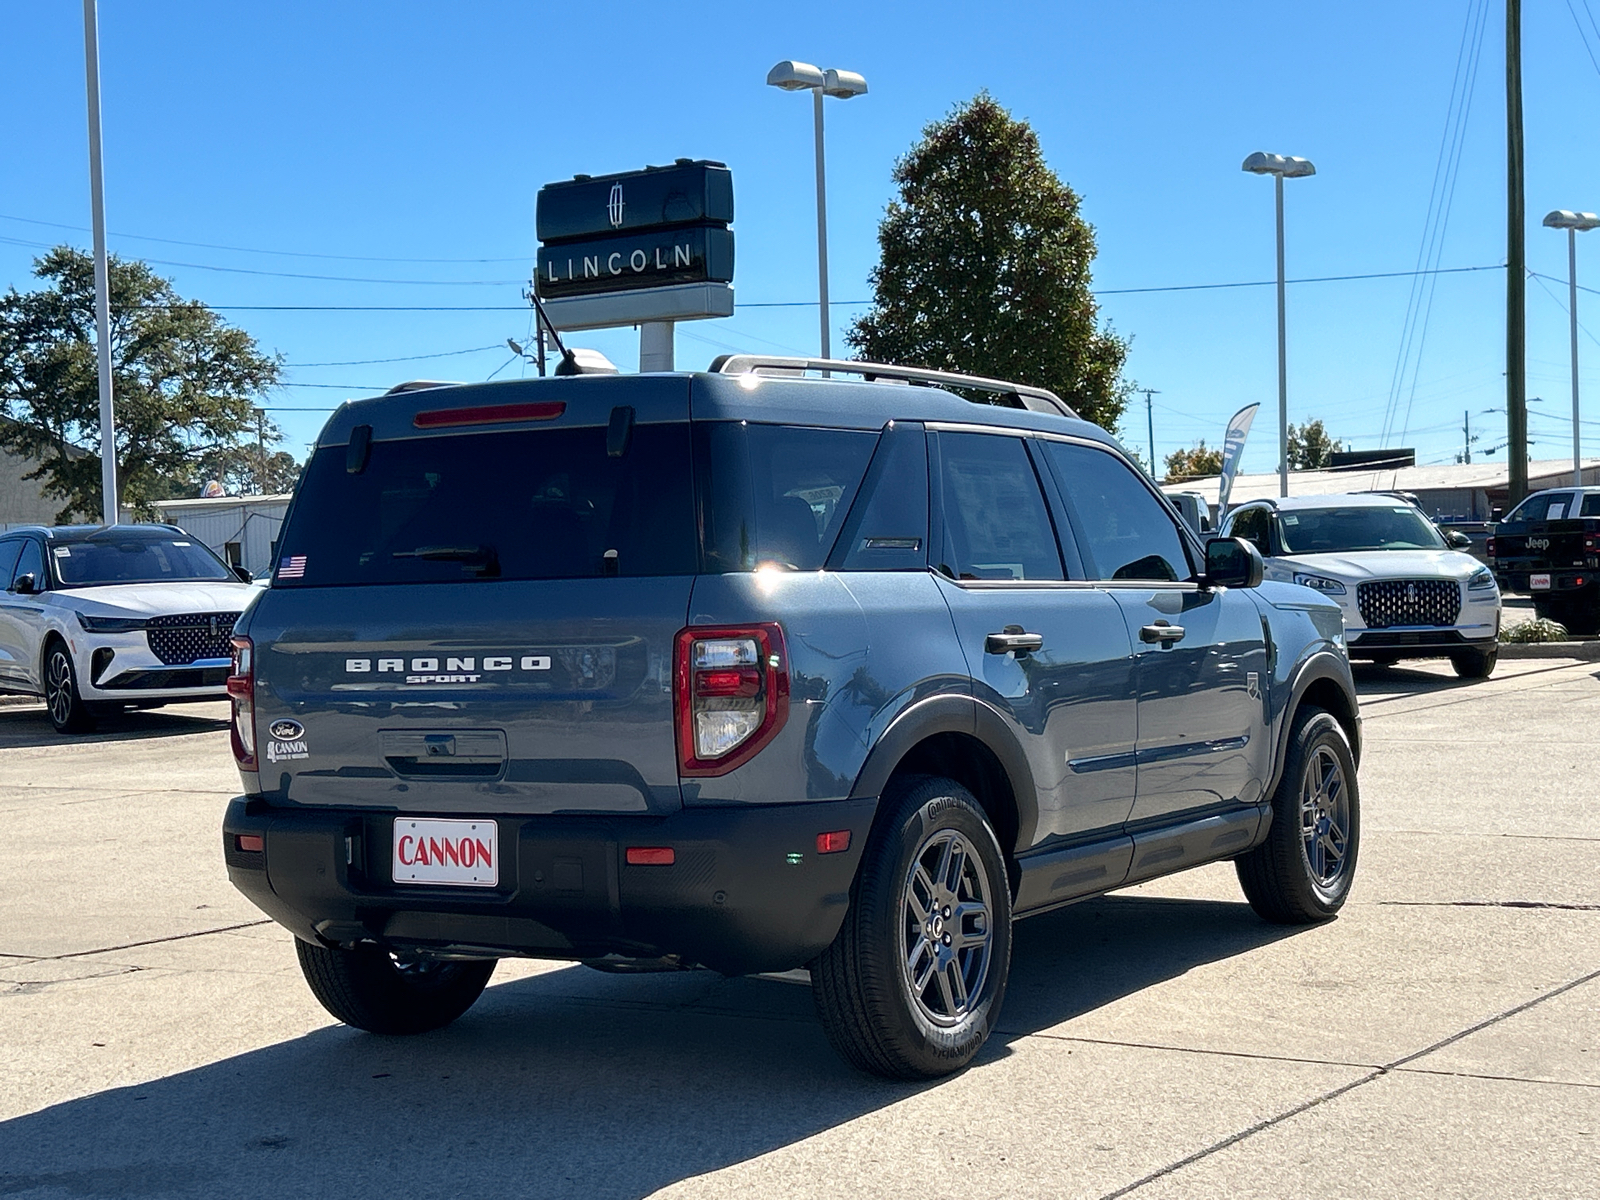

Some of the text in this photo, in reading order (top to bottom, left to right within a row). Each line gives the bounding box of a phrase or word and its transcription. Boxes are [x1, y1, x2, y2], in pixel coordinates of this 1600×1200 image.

[548, 244, 690, 282] LINCOLN
[1525, 537, 1550, 550] Jeep
[345, 656, 551, 672] BRONCO
[406, 674, 481, 684] SPORT
[275, 723, 295, 736] Ford
[275, 741, 308, 754] CANNON
[398, 835, 492, 869] CANNON
